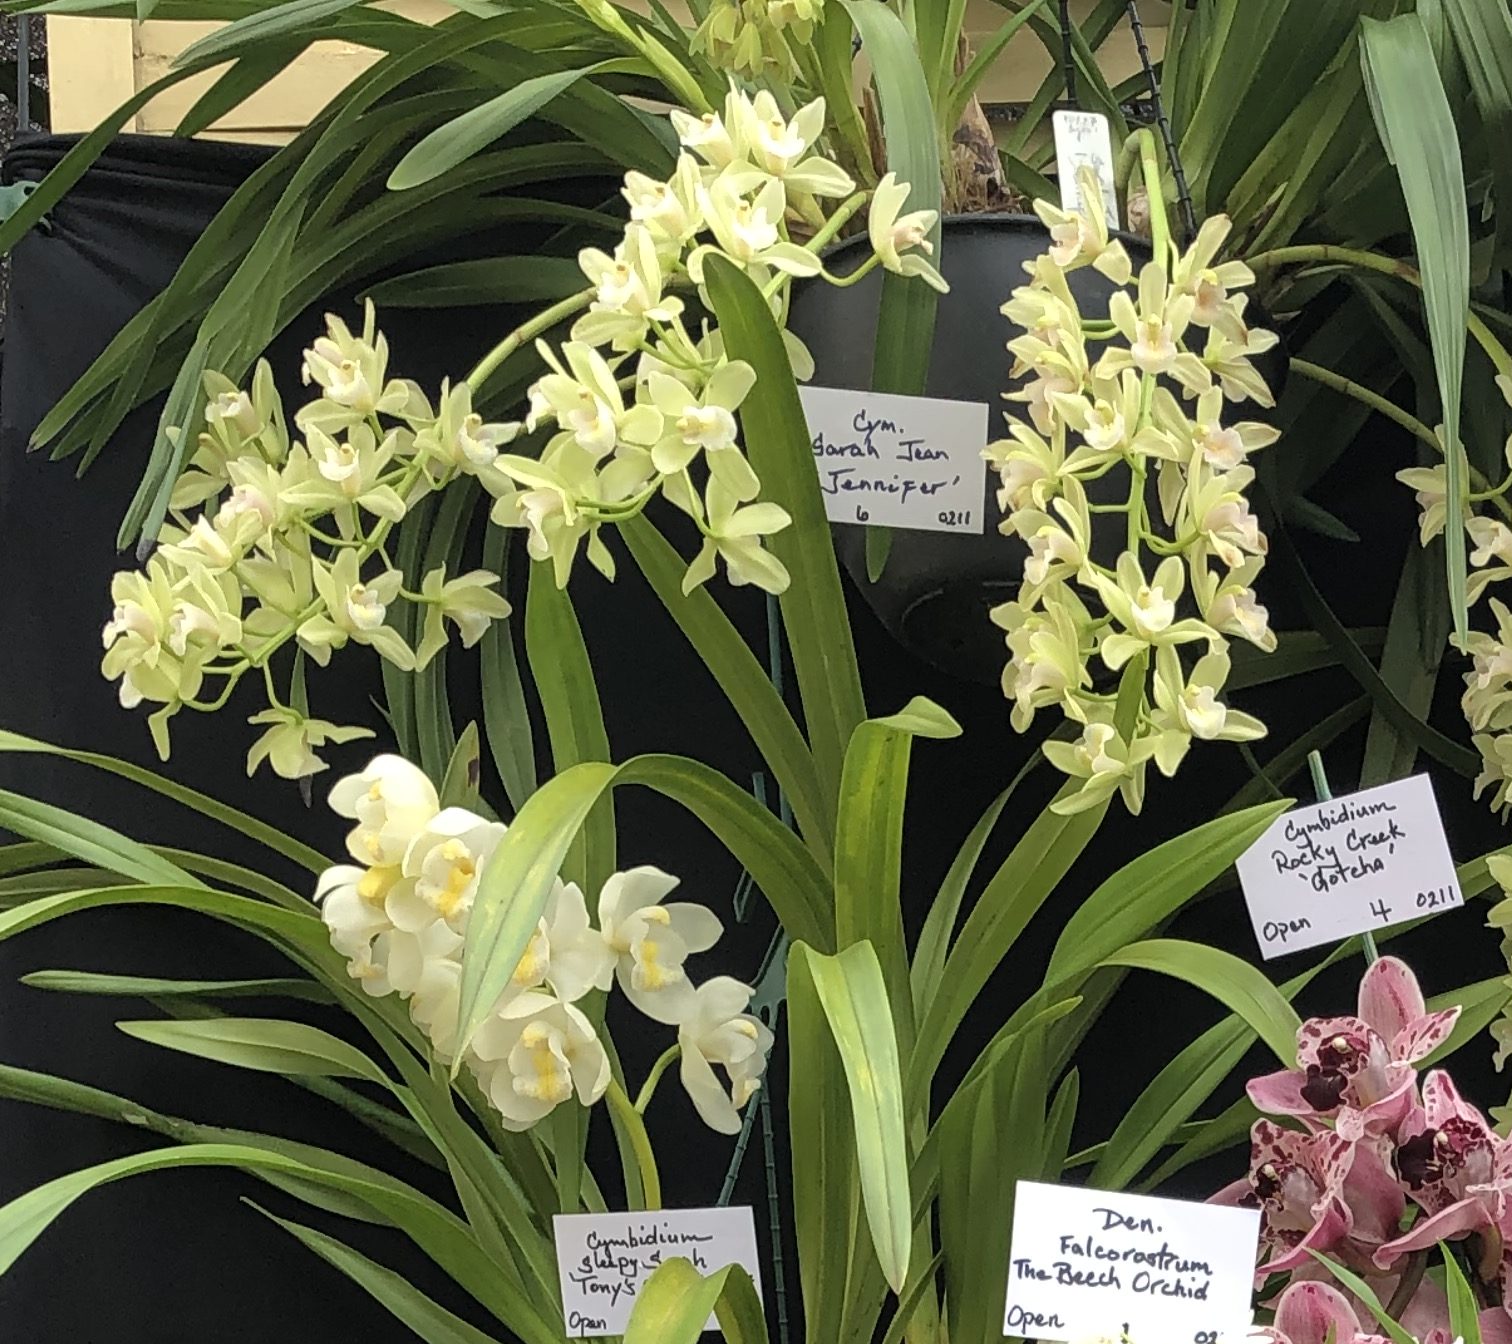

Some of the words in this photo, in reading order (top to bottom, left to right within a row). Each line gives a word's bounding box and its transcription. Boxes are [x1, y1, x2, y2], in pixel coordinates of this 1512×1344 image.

[854, 409, 904, 440] Cym.
[812, 432, 879, 459] Sarah
[896, 439, 949, 461] Jean
[856, 505, 869, 521] 6
[938, 511, 970, 525] 0211
[1285, 802, 1396, 849] Cymbidium
[1271, 844, 1341, 874] Rocky
[1346, 819, 1405, 851] Creek
[1263, 917, 1311, 942] Open
[1369, 899, 1392, 922] 4
[1416, 885, 1455, 908] 0211
[1092, 1208, 1162, 1234] Den.
[586, 1222, 713, 1251] Cymbidium
[1013, 1259, 1052, 1281] The
[1052, 1262, 1121, 1289] Beech
[1132, 1271, 1210, 1301] Orchid
[569, 1311, 606, 1337] Open
[1007, 1305, 1065, 1335] Open
